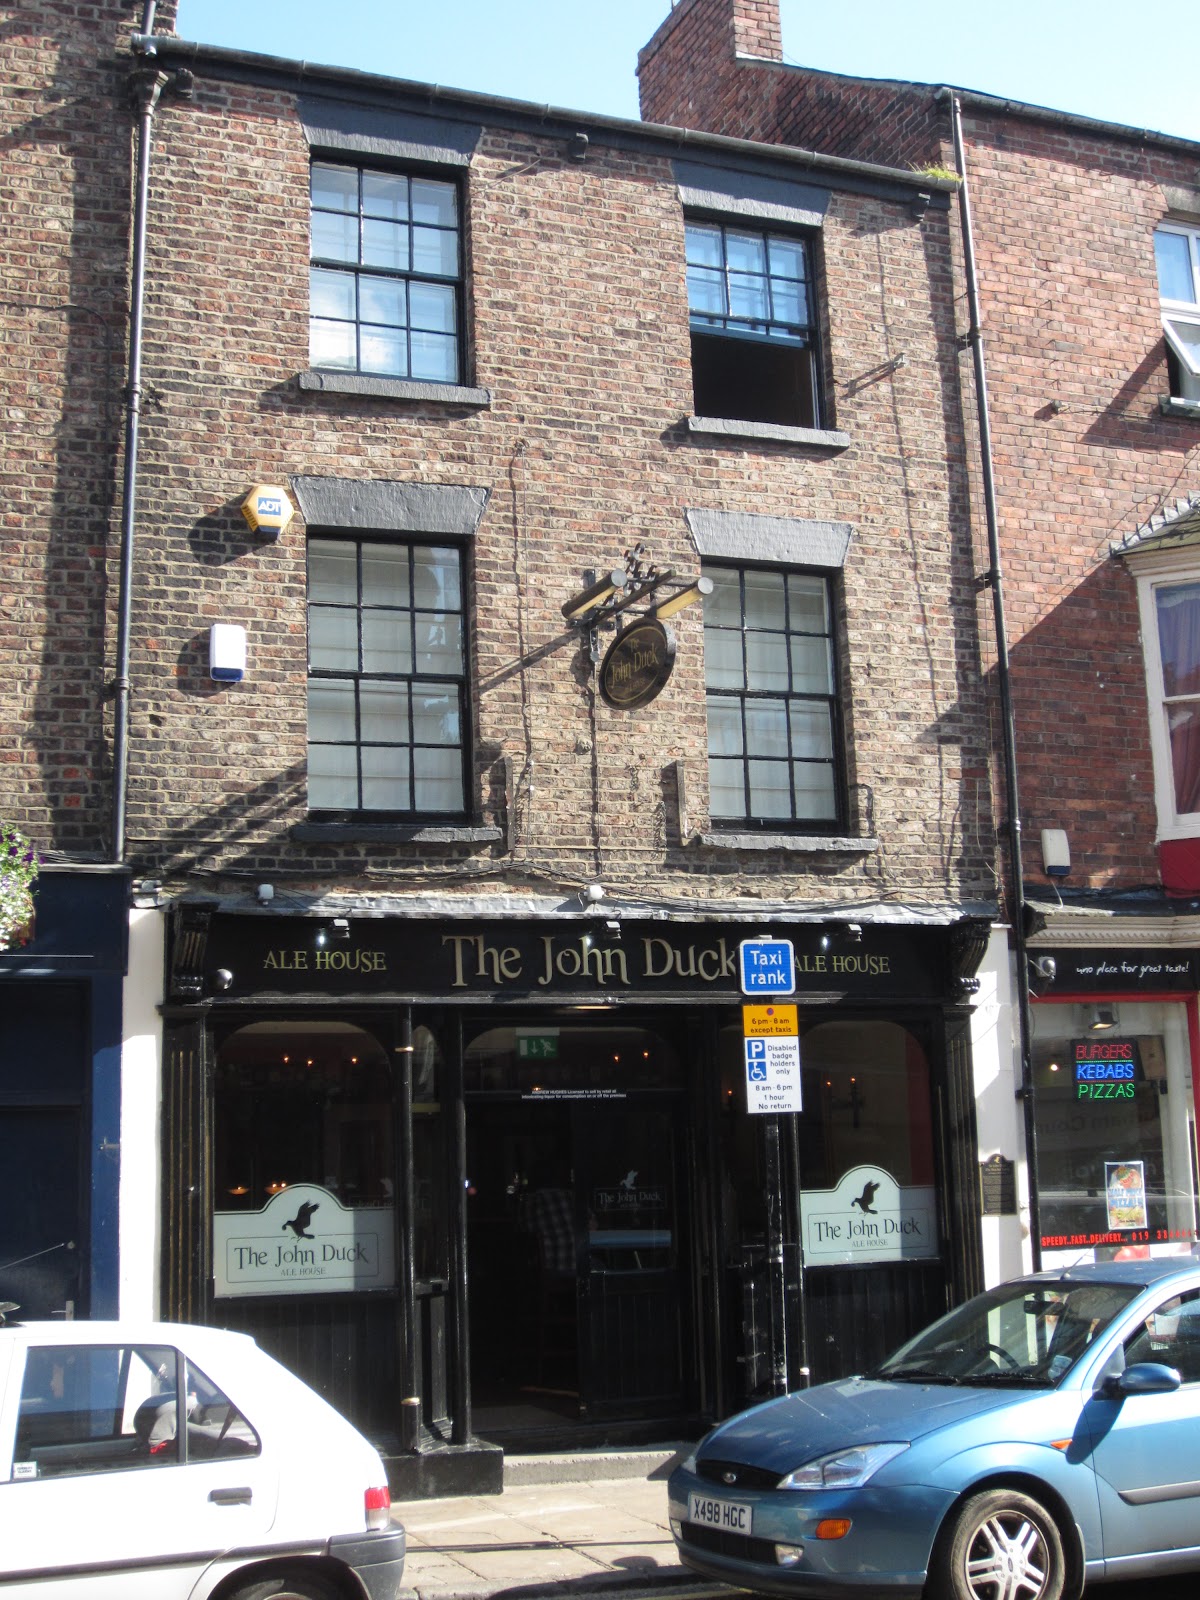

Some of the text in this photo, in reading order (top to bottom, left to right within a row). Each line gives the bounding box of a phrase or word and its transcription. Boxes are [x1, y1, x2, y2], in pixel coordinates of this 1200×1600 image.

[258, 500, 281, 512] ADT
[611, 660, 632, 689] John
[634, 642, 660, 673] Duck
[263, 949, 388, 974] ALE HOUSE
[442, 934, 736, 988] The John Duck
[750, 950, 783, 966] Taxi
[794, 954, 890, 976] ALE HOUSE
[751, 970, 786, 985] rank
[1096, 962, 1118, 976] place
[1120, 961, 1138, 973] for
[1138, 964, 1162, 978] great
[1165, 961, 1190, 973] taste!
[751, 1041, 763, 1058] P
[1076, 1044, 1132, 1060] BURGERS
[1076, 1064, 1134, 1080] KEBABS
[1078, 1083, 1135, 1099] PIZZAS
[814, 1216, 922, 1242] The John Duck
[866, 1239, 888, 1247] HOUSE
[234, 1242, 369, 1270] The John Duck
[280, 1266, 326, 1276] ALE HOUSE
[694, 1498, 746, 1528] X498 HGC
